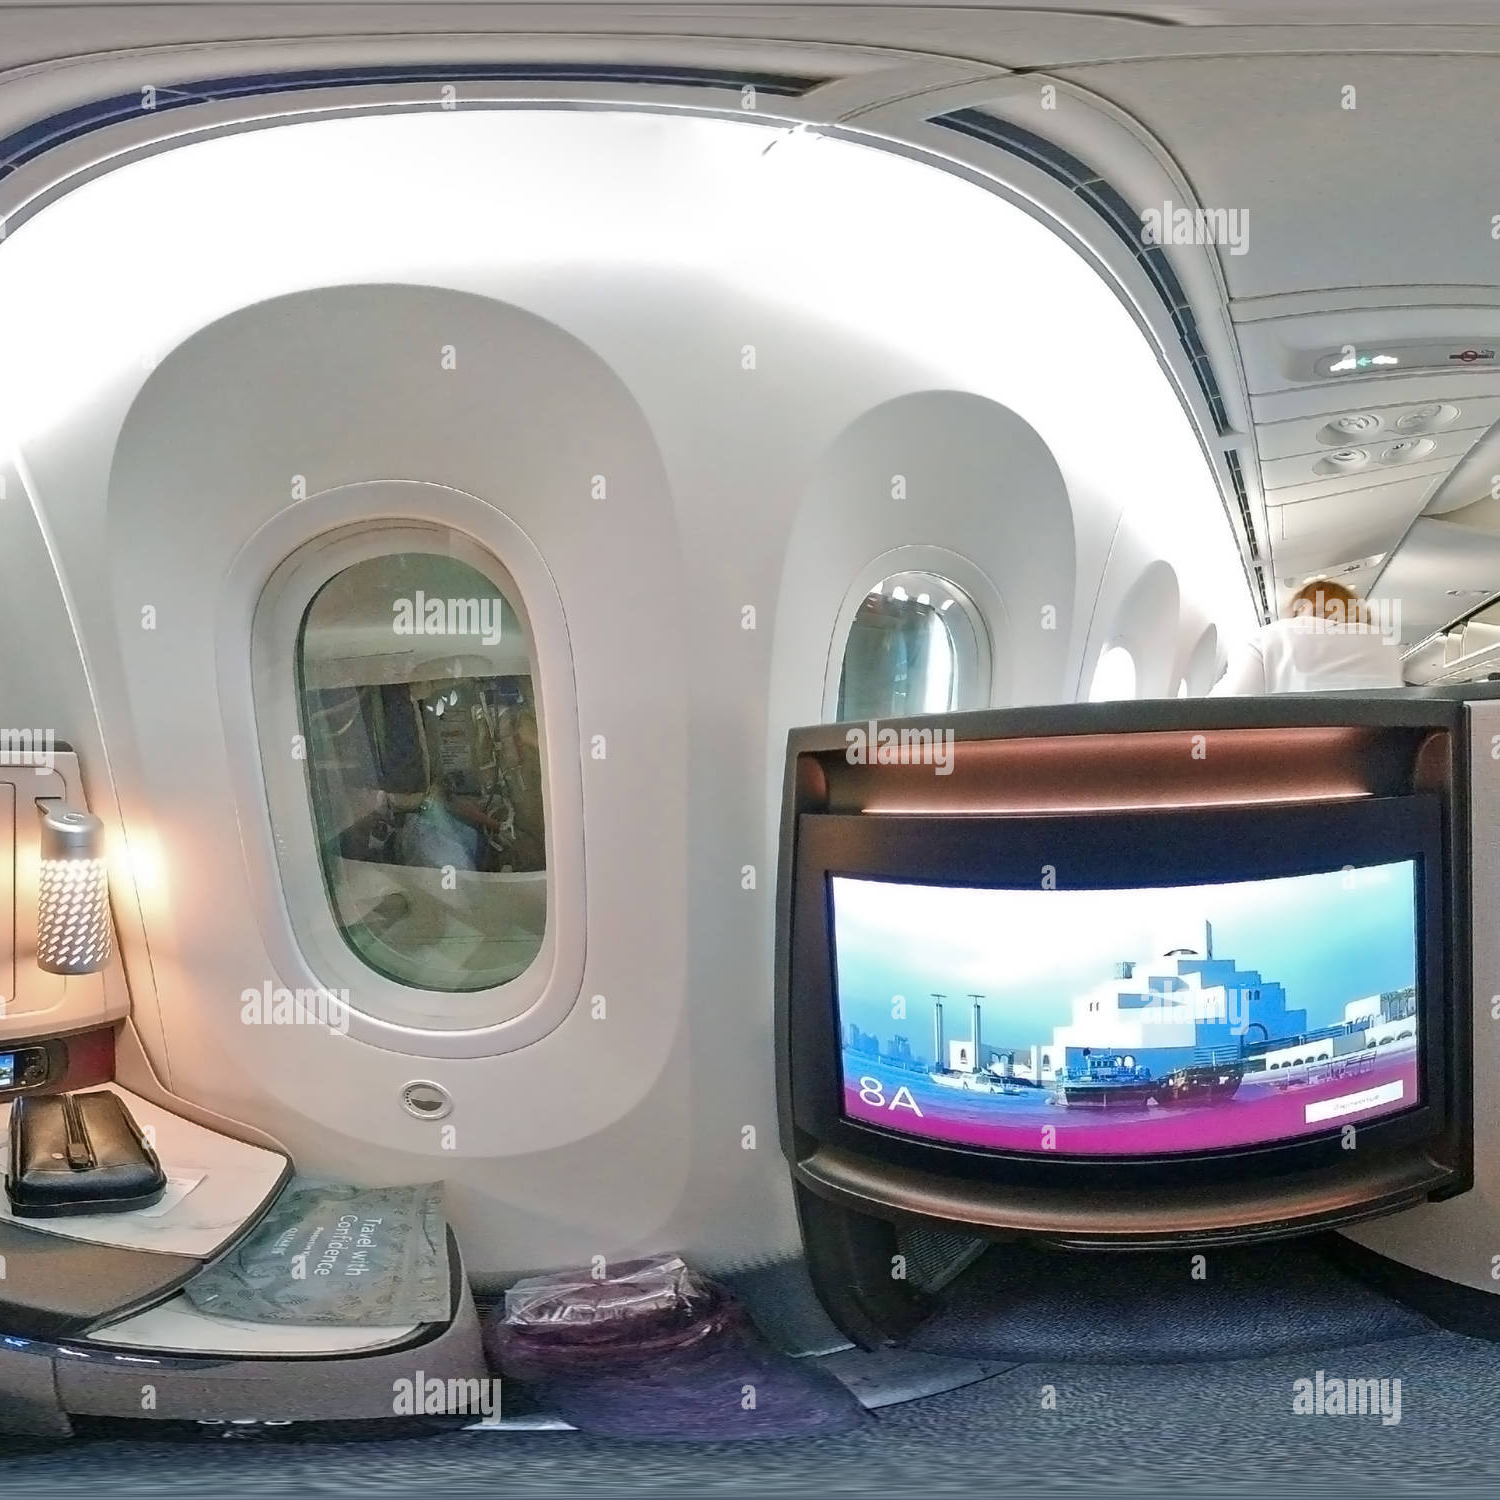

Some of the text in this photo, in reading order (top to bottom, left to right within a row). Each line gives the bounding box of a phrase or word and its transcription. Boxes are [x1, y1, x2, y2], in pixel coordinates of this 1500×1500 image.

[860, 1076, 924, 1118] 8A
[314, 1214, 358, 1276] Confidence
[345, 1218, 382, 1276] Travel with
